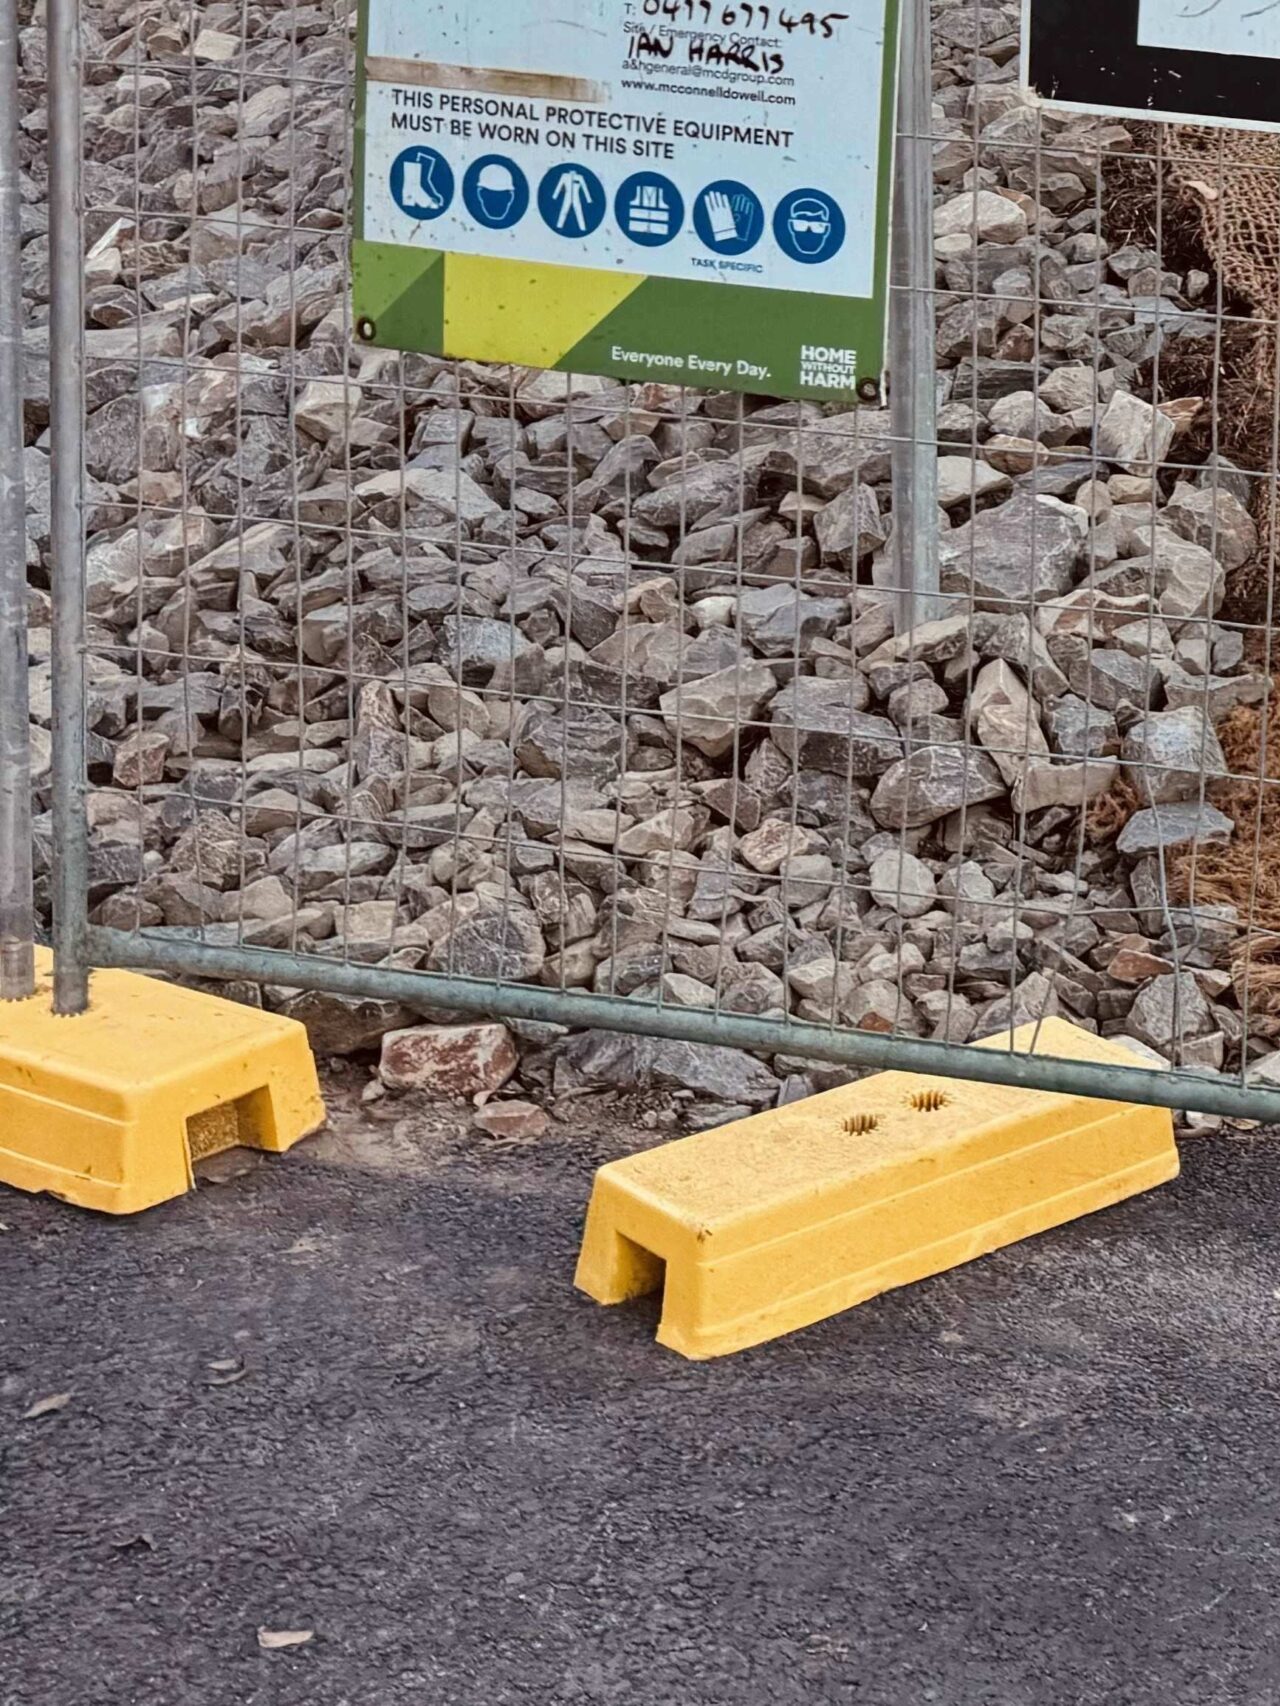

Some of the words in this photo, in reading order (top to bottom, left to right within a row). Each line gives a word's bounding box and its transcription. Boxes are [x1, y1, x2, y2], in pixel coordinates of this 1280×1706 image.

[623, 21, 646, 34] Site
[658, 25, 727, 44] Emergency
[779, 8, 849, 38] 495
[628, 32, 673, 59] IAN
[689, 38, 784, 74] HARRIS
[621, 79, 795, 105] www.mcconnelldowell.com
[392, 89, 433, 108] THIS
[439, 95, 539, 121] PERSONAL
[546, 106, 666, 134] PROTECTIVE
[673, 120, 794, 147] EQUIPMENT
[391, 112, 444, 133] MUST
[450, 120, 472, 137] BE
[478, 122, 539, 145] WORN
[546, 131, 576, 148] ON
[582, 134, 627, 154] THIS
[633, 140, 674, 159] SITE
[691, 258, 716, 268] TASK
[719, 261, 763, 273] SPECIFIC
[611, 346, 684, 368] Everyone
[688, 355, 732, 376] Every
[736, 360, 771, 380] Day.
[800, 361, 856, 374] WITHOUT
[801, 345, 857, 364] HOME
[800, 371, 856, 390] HARM
